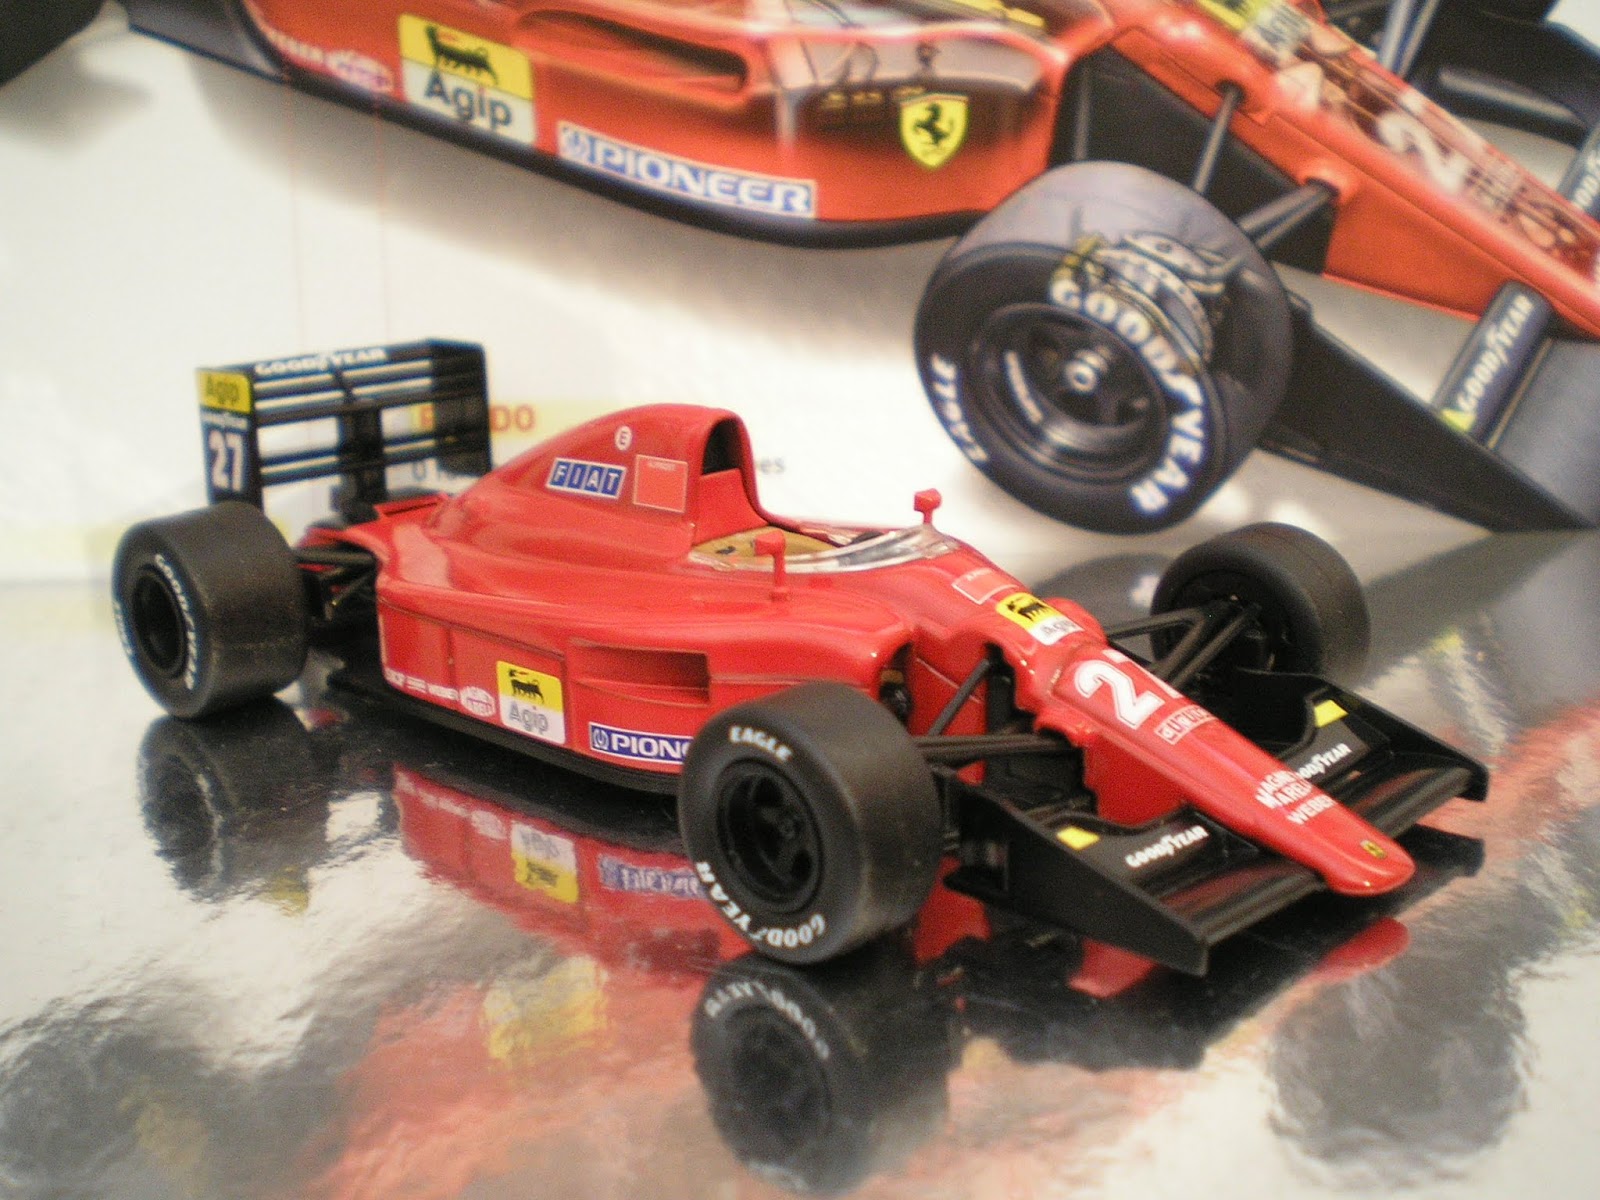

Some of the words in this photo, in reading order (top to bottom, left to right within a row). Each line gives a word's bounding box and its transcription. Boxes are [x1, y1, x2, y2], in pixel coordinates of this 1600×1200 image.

[423, 70, 513, 130] Agip
[595, 139, 811, 214] PIONEER
[254, 347, 388, 376] GOODYEAR
[1456, 294, 1536, 413] GOODYEAR
[1049, 279, 1205, 513] GOODYEAR
[207, 430, 244, 492] 27
[552, 463, 619, 496] FIAT
[508, 701, 549, 735] Agip
[729, 725, 793, 763] EAGLE
[1296, 743, 1353, 780] OODYEAR
[1124, 825, 1210, 869] GOODYEAR
[695, 861, 826, 949] GOODYEAR
